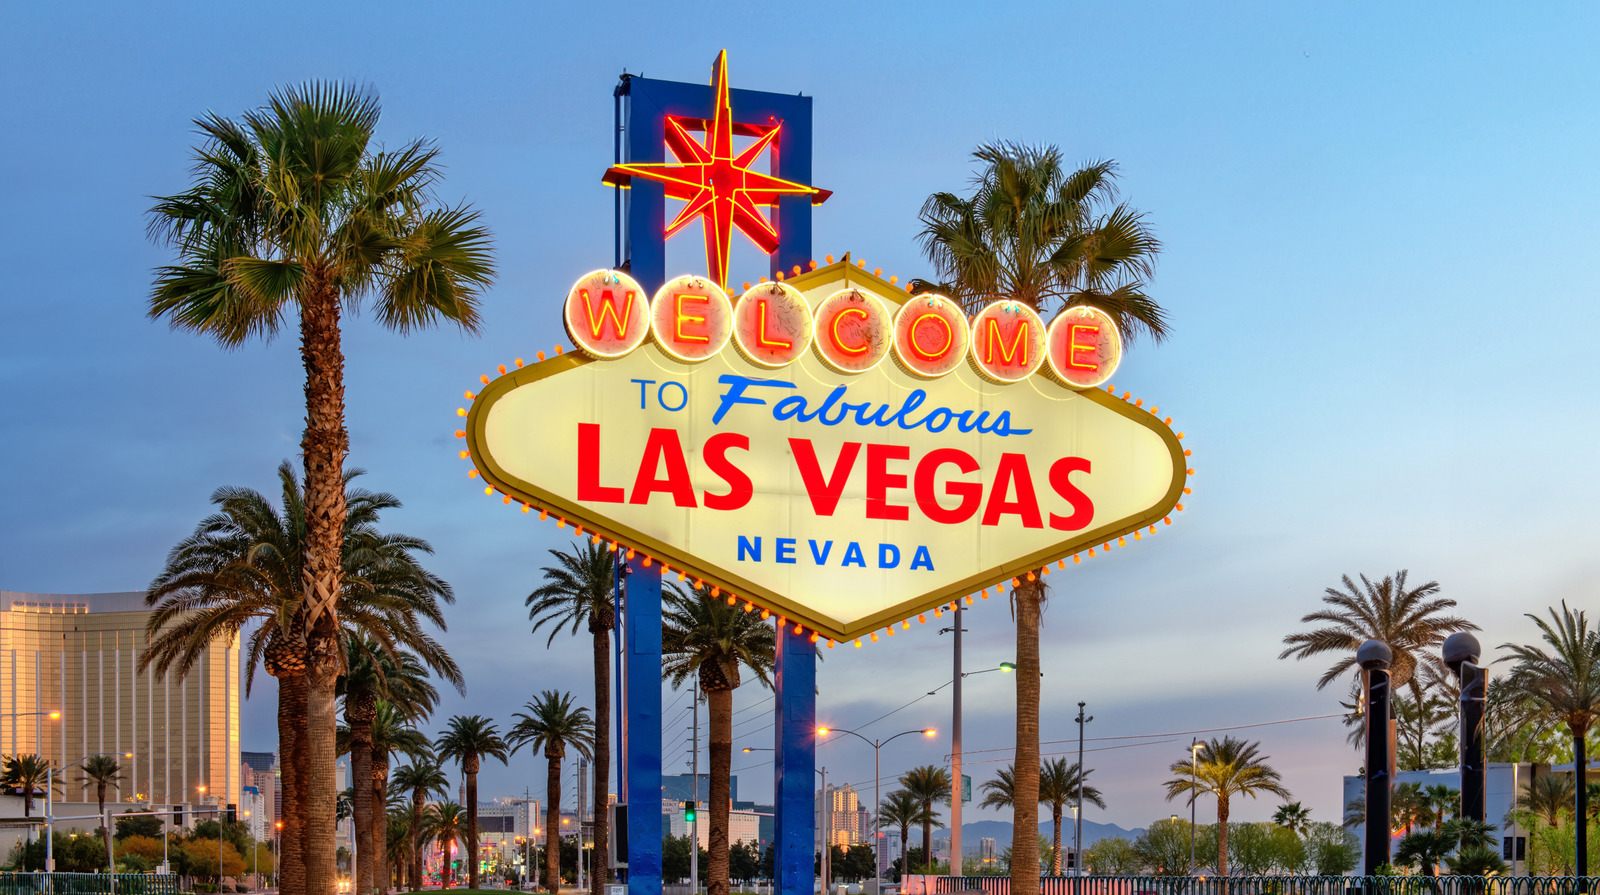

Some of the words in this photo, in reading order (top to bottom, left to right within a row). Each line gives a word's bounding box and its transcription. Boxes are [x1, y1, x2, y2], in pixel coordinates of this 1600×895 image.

[579, 288, 1099, 371] WELCOME
[631, 378, 688, 412] TO
[713, 374, 1033, 437] Fabulous
[577, 423, 753, 511] LAS
[789, 438, 1094, 531] VEGAS
[737, 535, 935, 572] NEVADA
